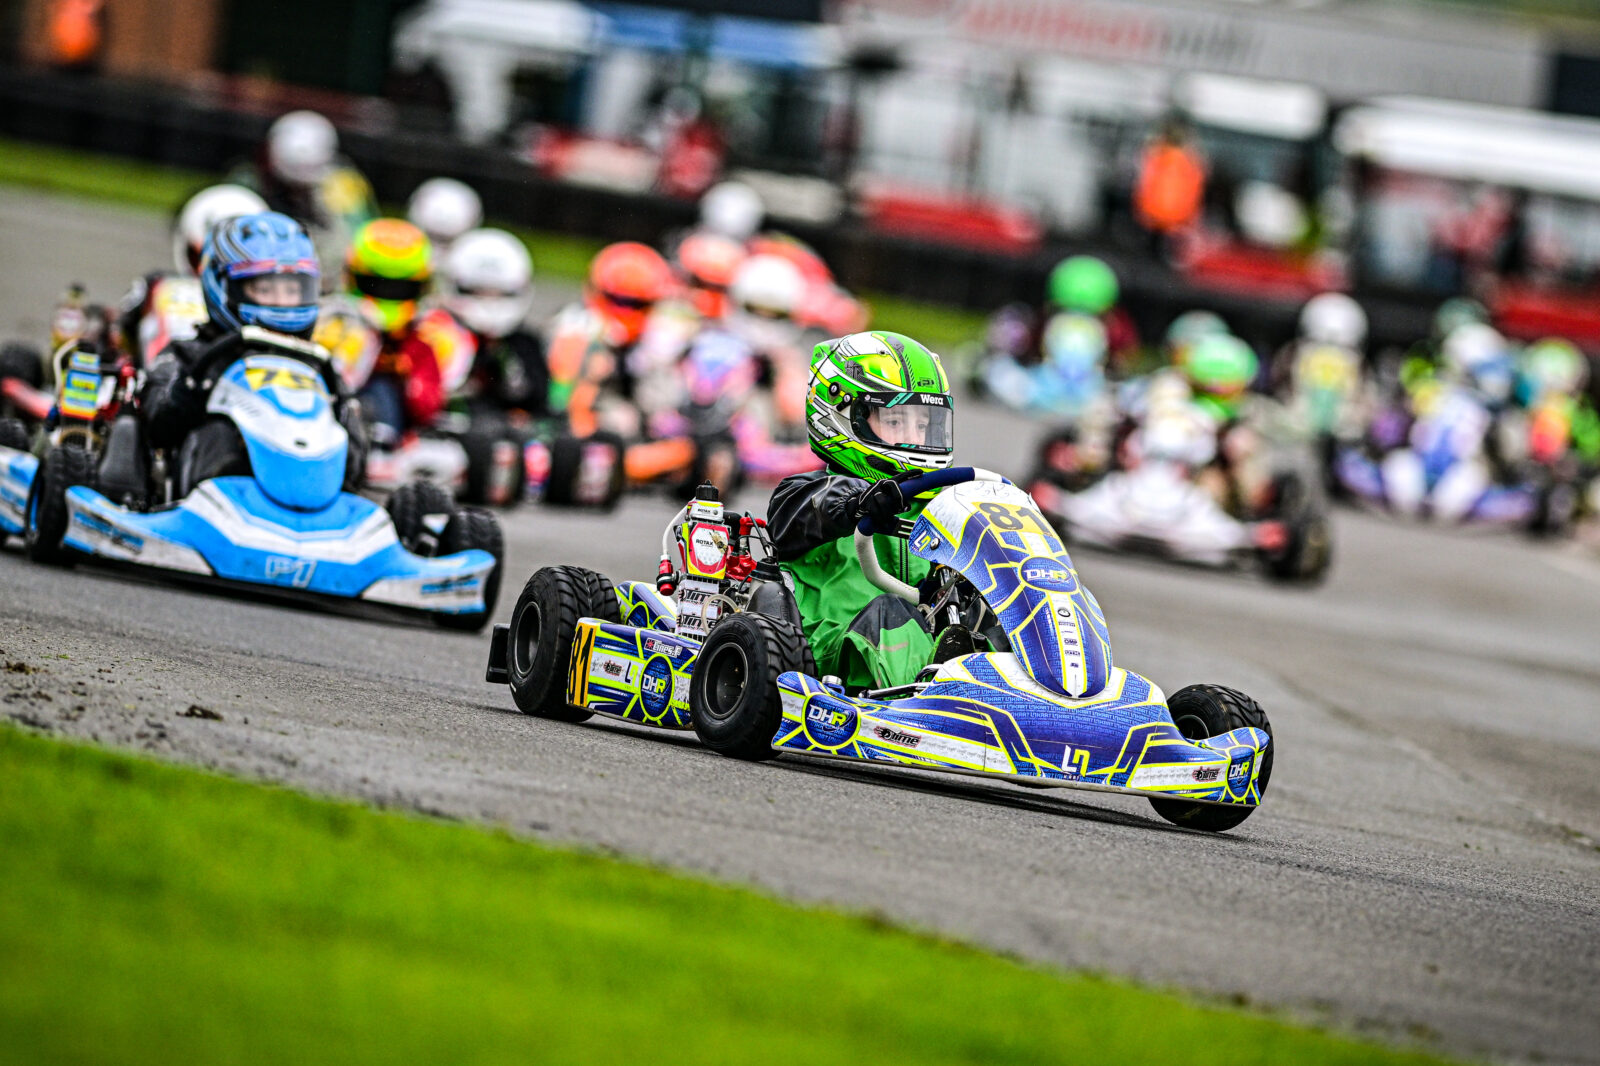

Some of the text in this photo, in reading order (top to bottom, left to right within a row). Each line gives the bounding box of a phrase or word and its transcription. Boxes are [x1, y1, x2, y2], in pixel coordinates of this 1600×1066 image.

[919, 393, 944, 405] Wera
[979, 502, 1054, 537] 81
[696, 538, 714, 546] ROTAX
[1024, 568, 1069, 583] DHR
[568, 625, 594, 705] 81
[642, 673, 667, 694] DHR
[807, 704, 847, 726] DHR
[1229, 761, 1251, 778] DHR
